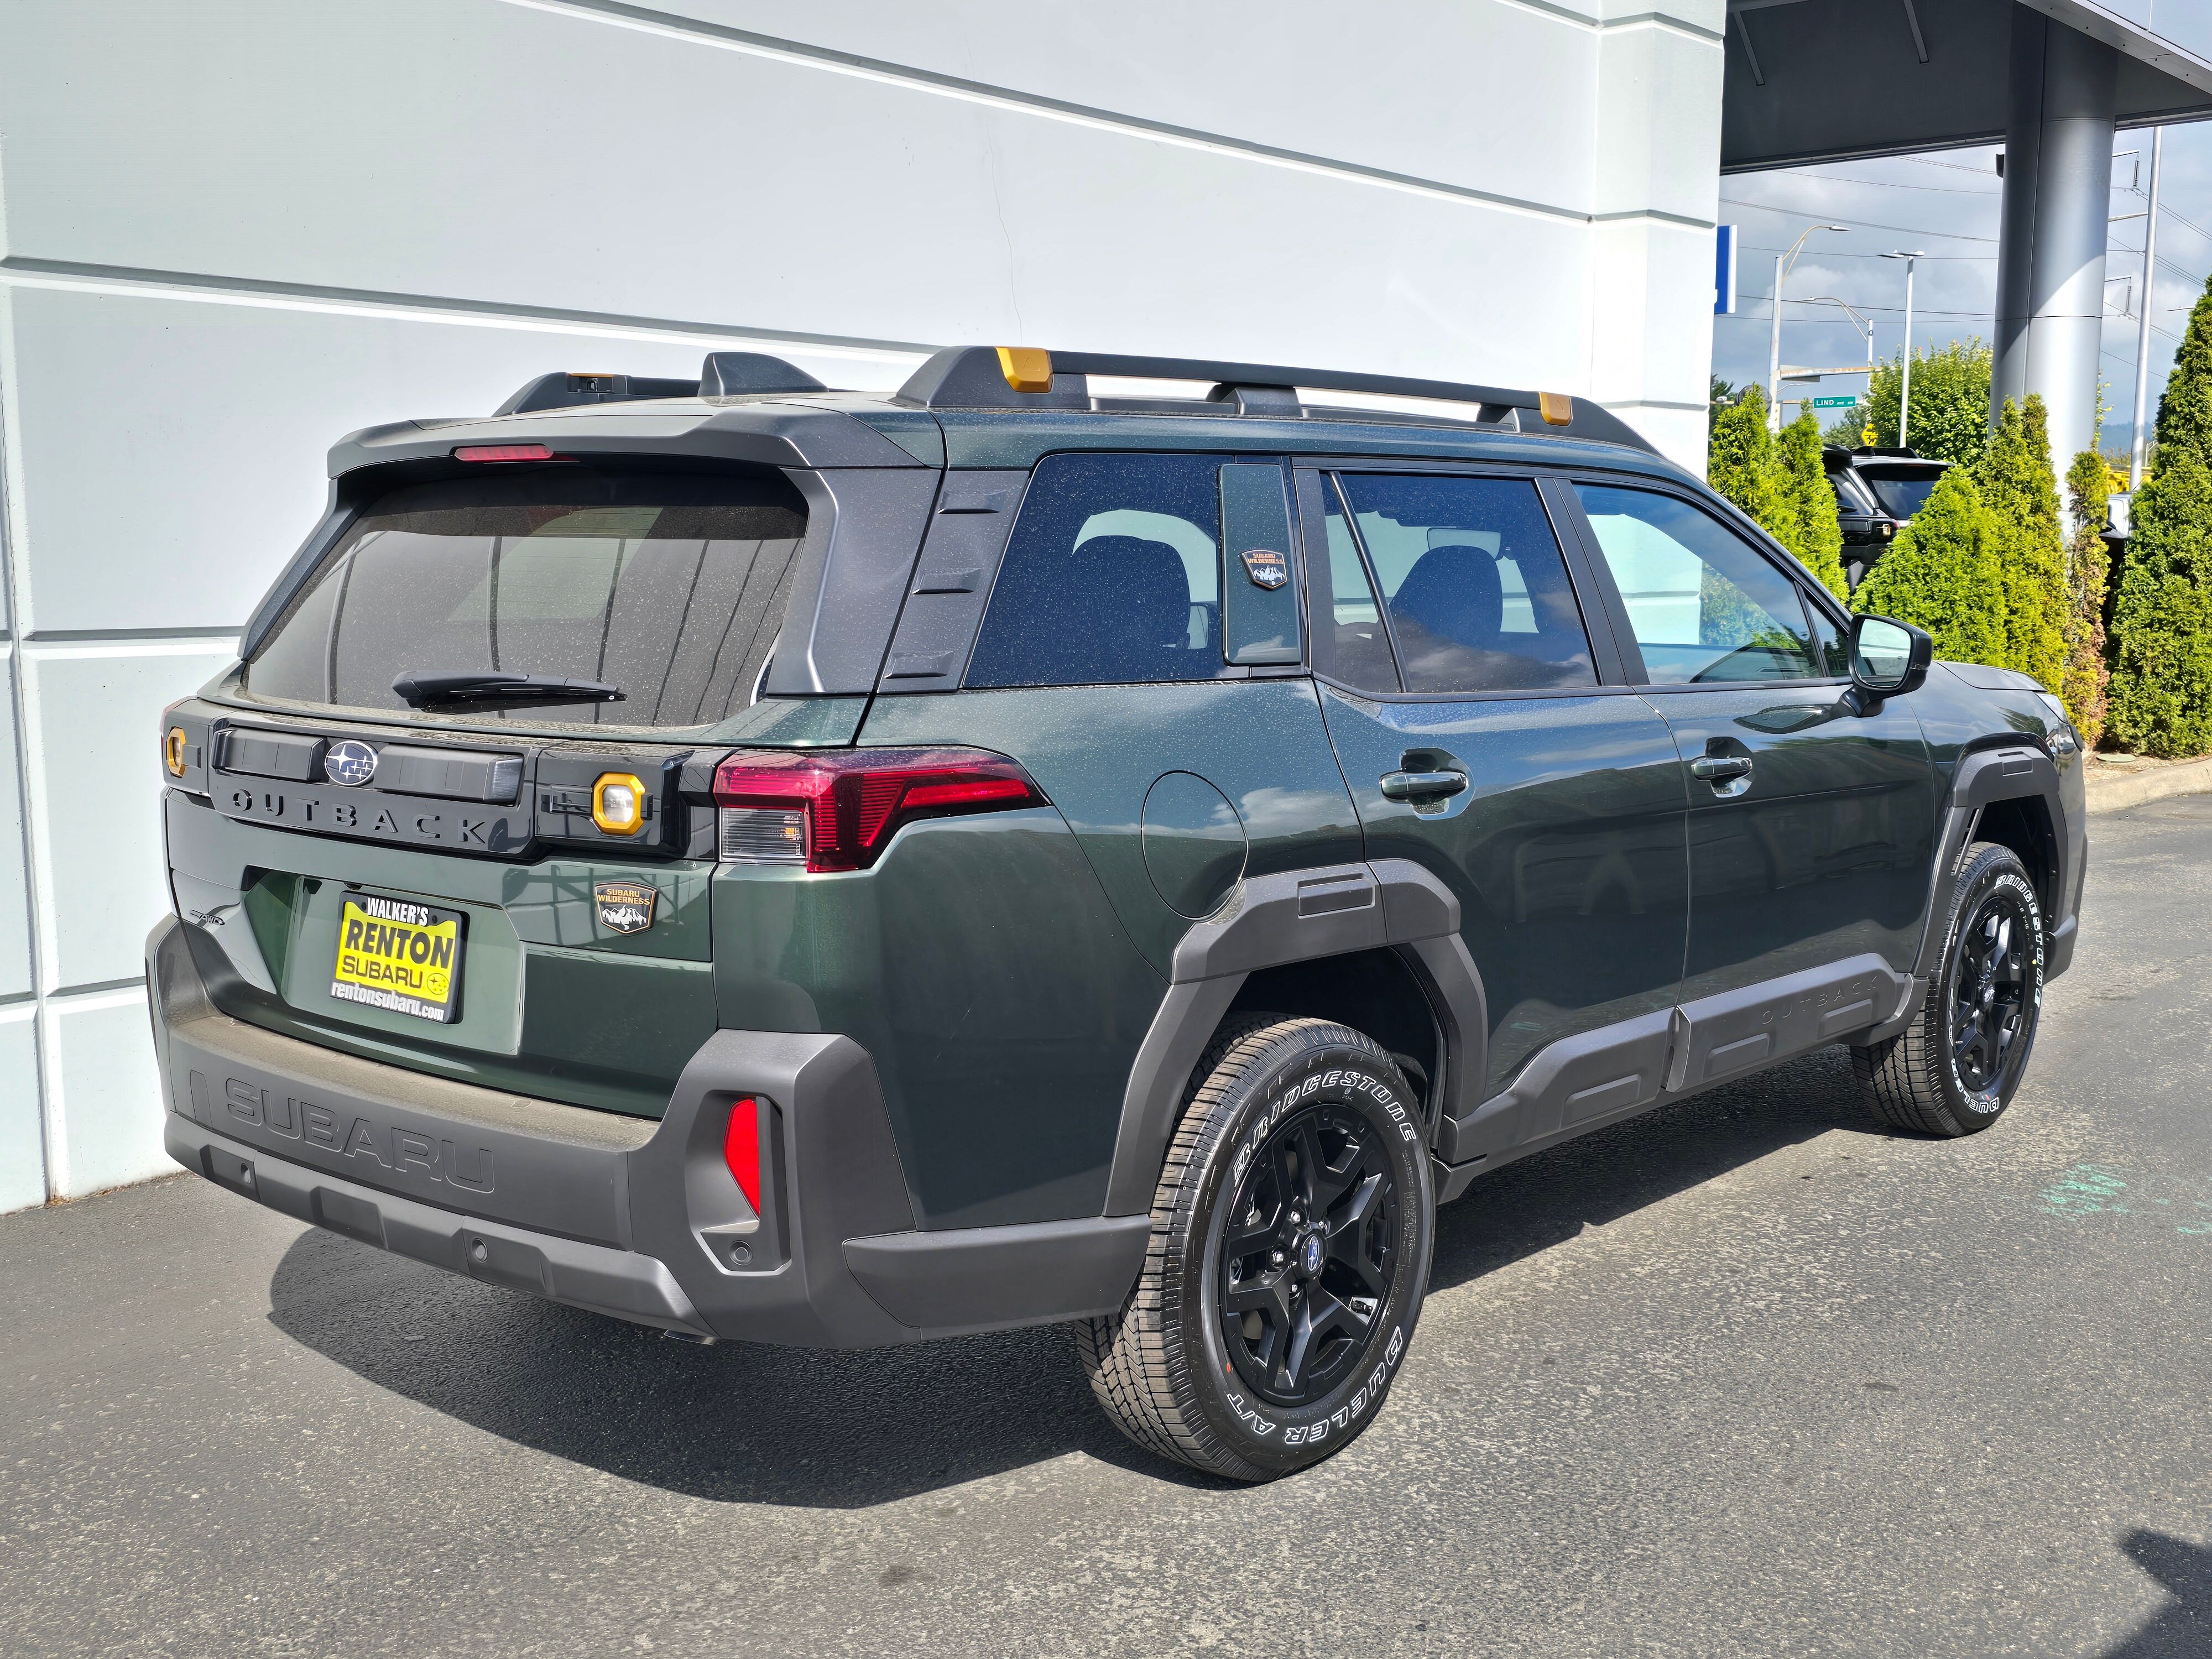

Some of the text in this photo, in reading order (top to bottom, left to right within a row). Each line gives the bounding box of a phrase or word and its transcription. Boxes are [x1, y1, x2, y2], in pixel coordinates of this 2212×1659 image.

[233, 788, 486, 844] OUTBACK
[367, 897, 429, 926] WALKER'S
[598, 894, 650, 905] WILDERNESS
[606, 888, 640, 898] SUBARU
[345, 919, 455, 969] RENTON
[342, 955, 423, 989] SUBARU
[331, 981, 445, 1021] rentonsubaru.com
[225, 1077, 495, 1194] SUBARU
[1233, 1070, 1417, 1187] BRIDGESTONE
[1285, 1326, 1403, 1444] DUELER
[1227, 1393, 1276, 1436] A/T
